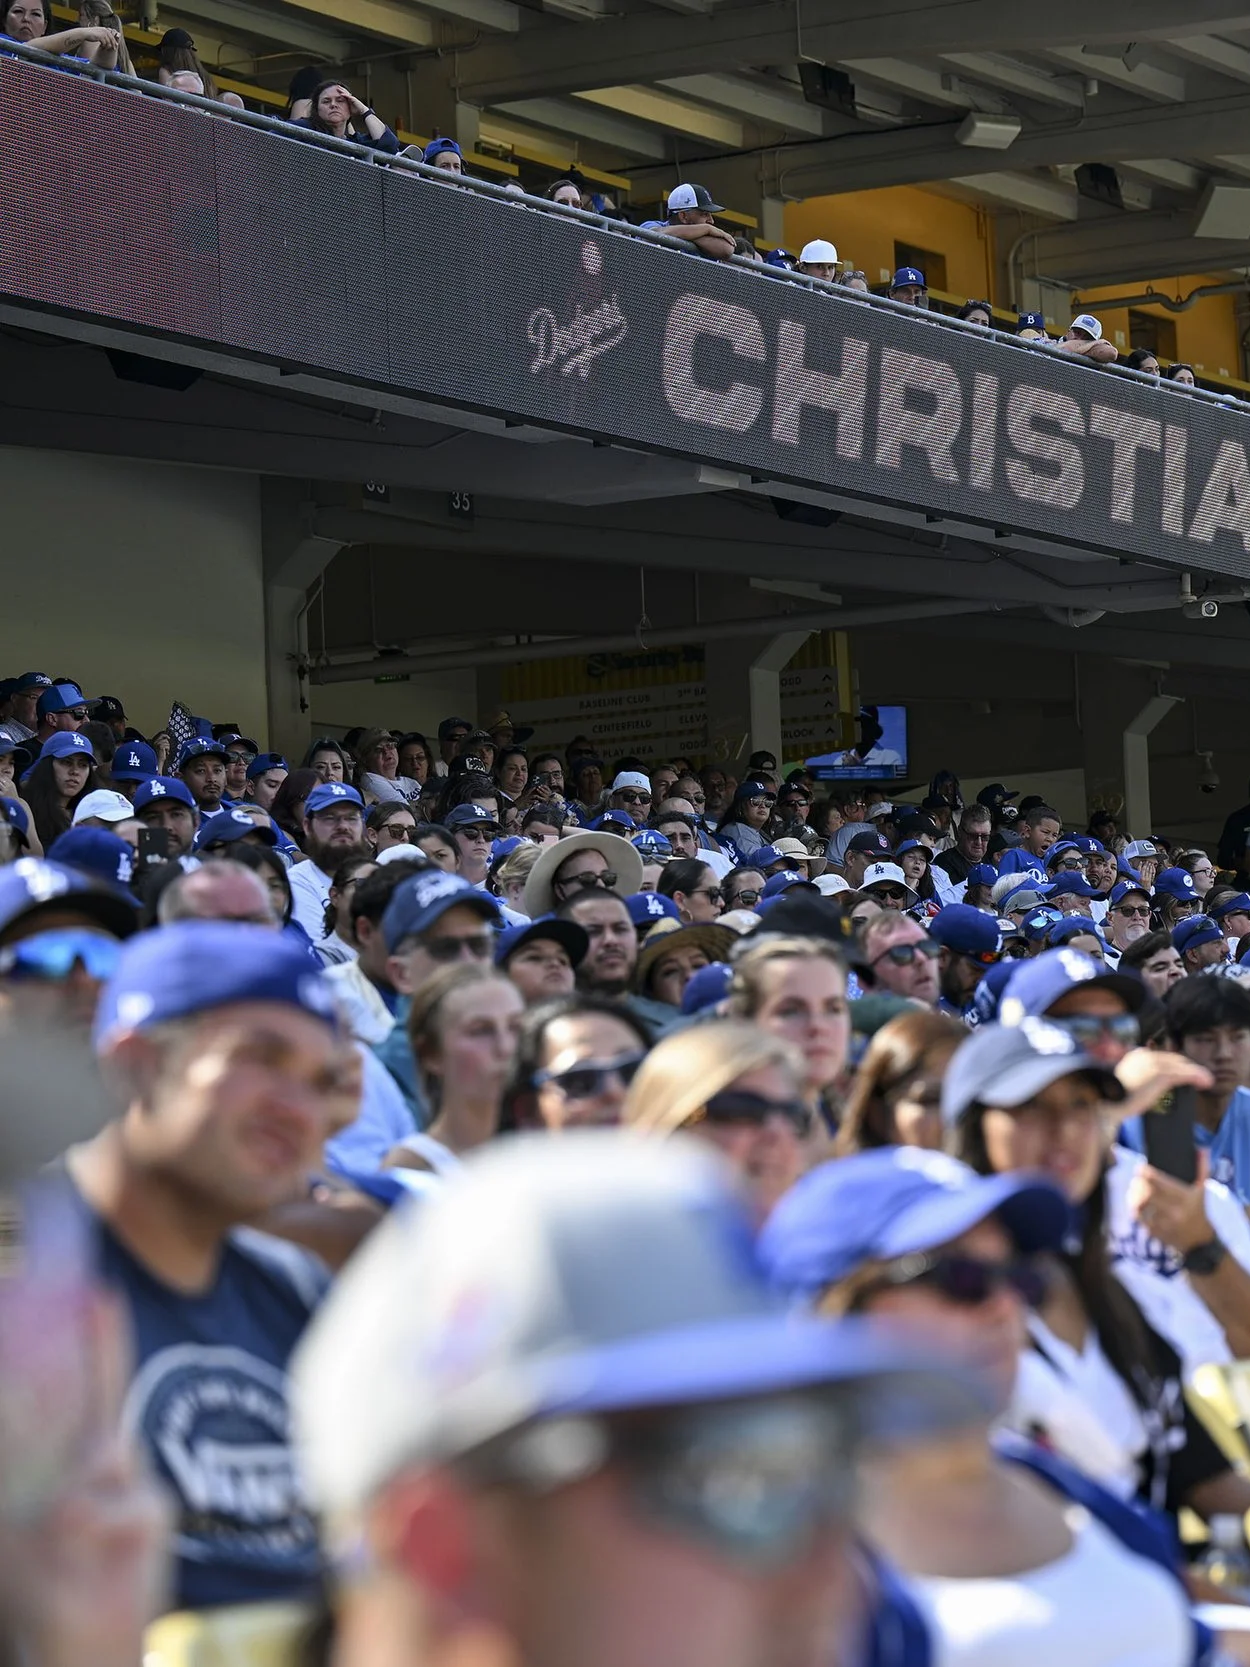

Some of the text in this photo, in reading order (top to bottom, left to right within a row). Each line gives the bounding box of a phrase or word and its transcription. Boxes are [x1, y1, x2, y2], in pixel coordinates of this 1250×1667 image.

[452, 491, 470, 511] 35
[579, 693, 650, 711] BASELINE CLUB
[592, 719, 652, 734] CENTERFIELD
[72, 733, 85, 747] LA
[129, 751, 141, 767] LA
[602, 745, 654, 759] PLAY AREA
[150, 779, 167, 796] LA
[472, 804, 487, 817] LA
[1088, 839, 1098, 851] LA
[874, 862, 885, 876] LA
[646, 895, 664, 915] LA
